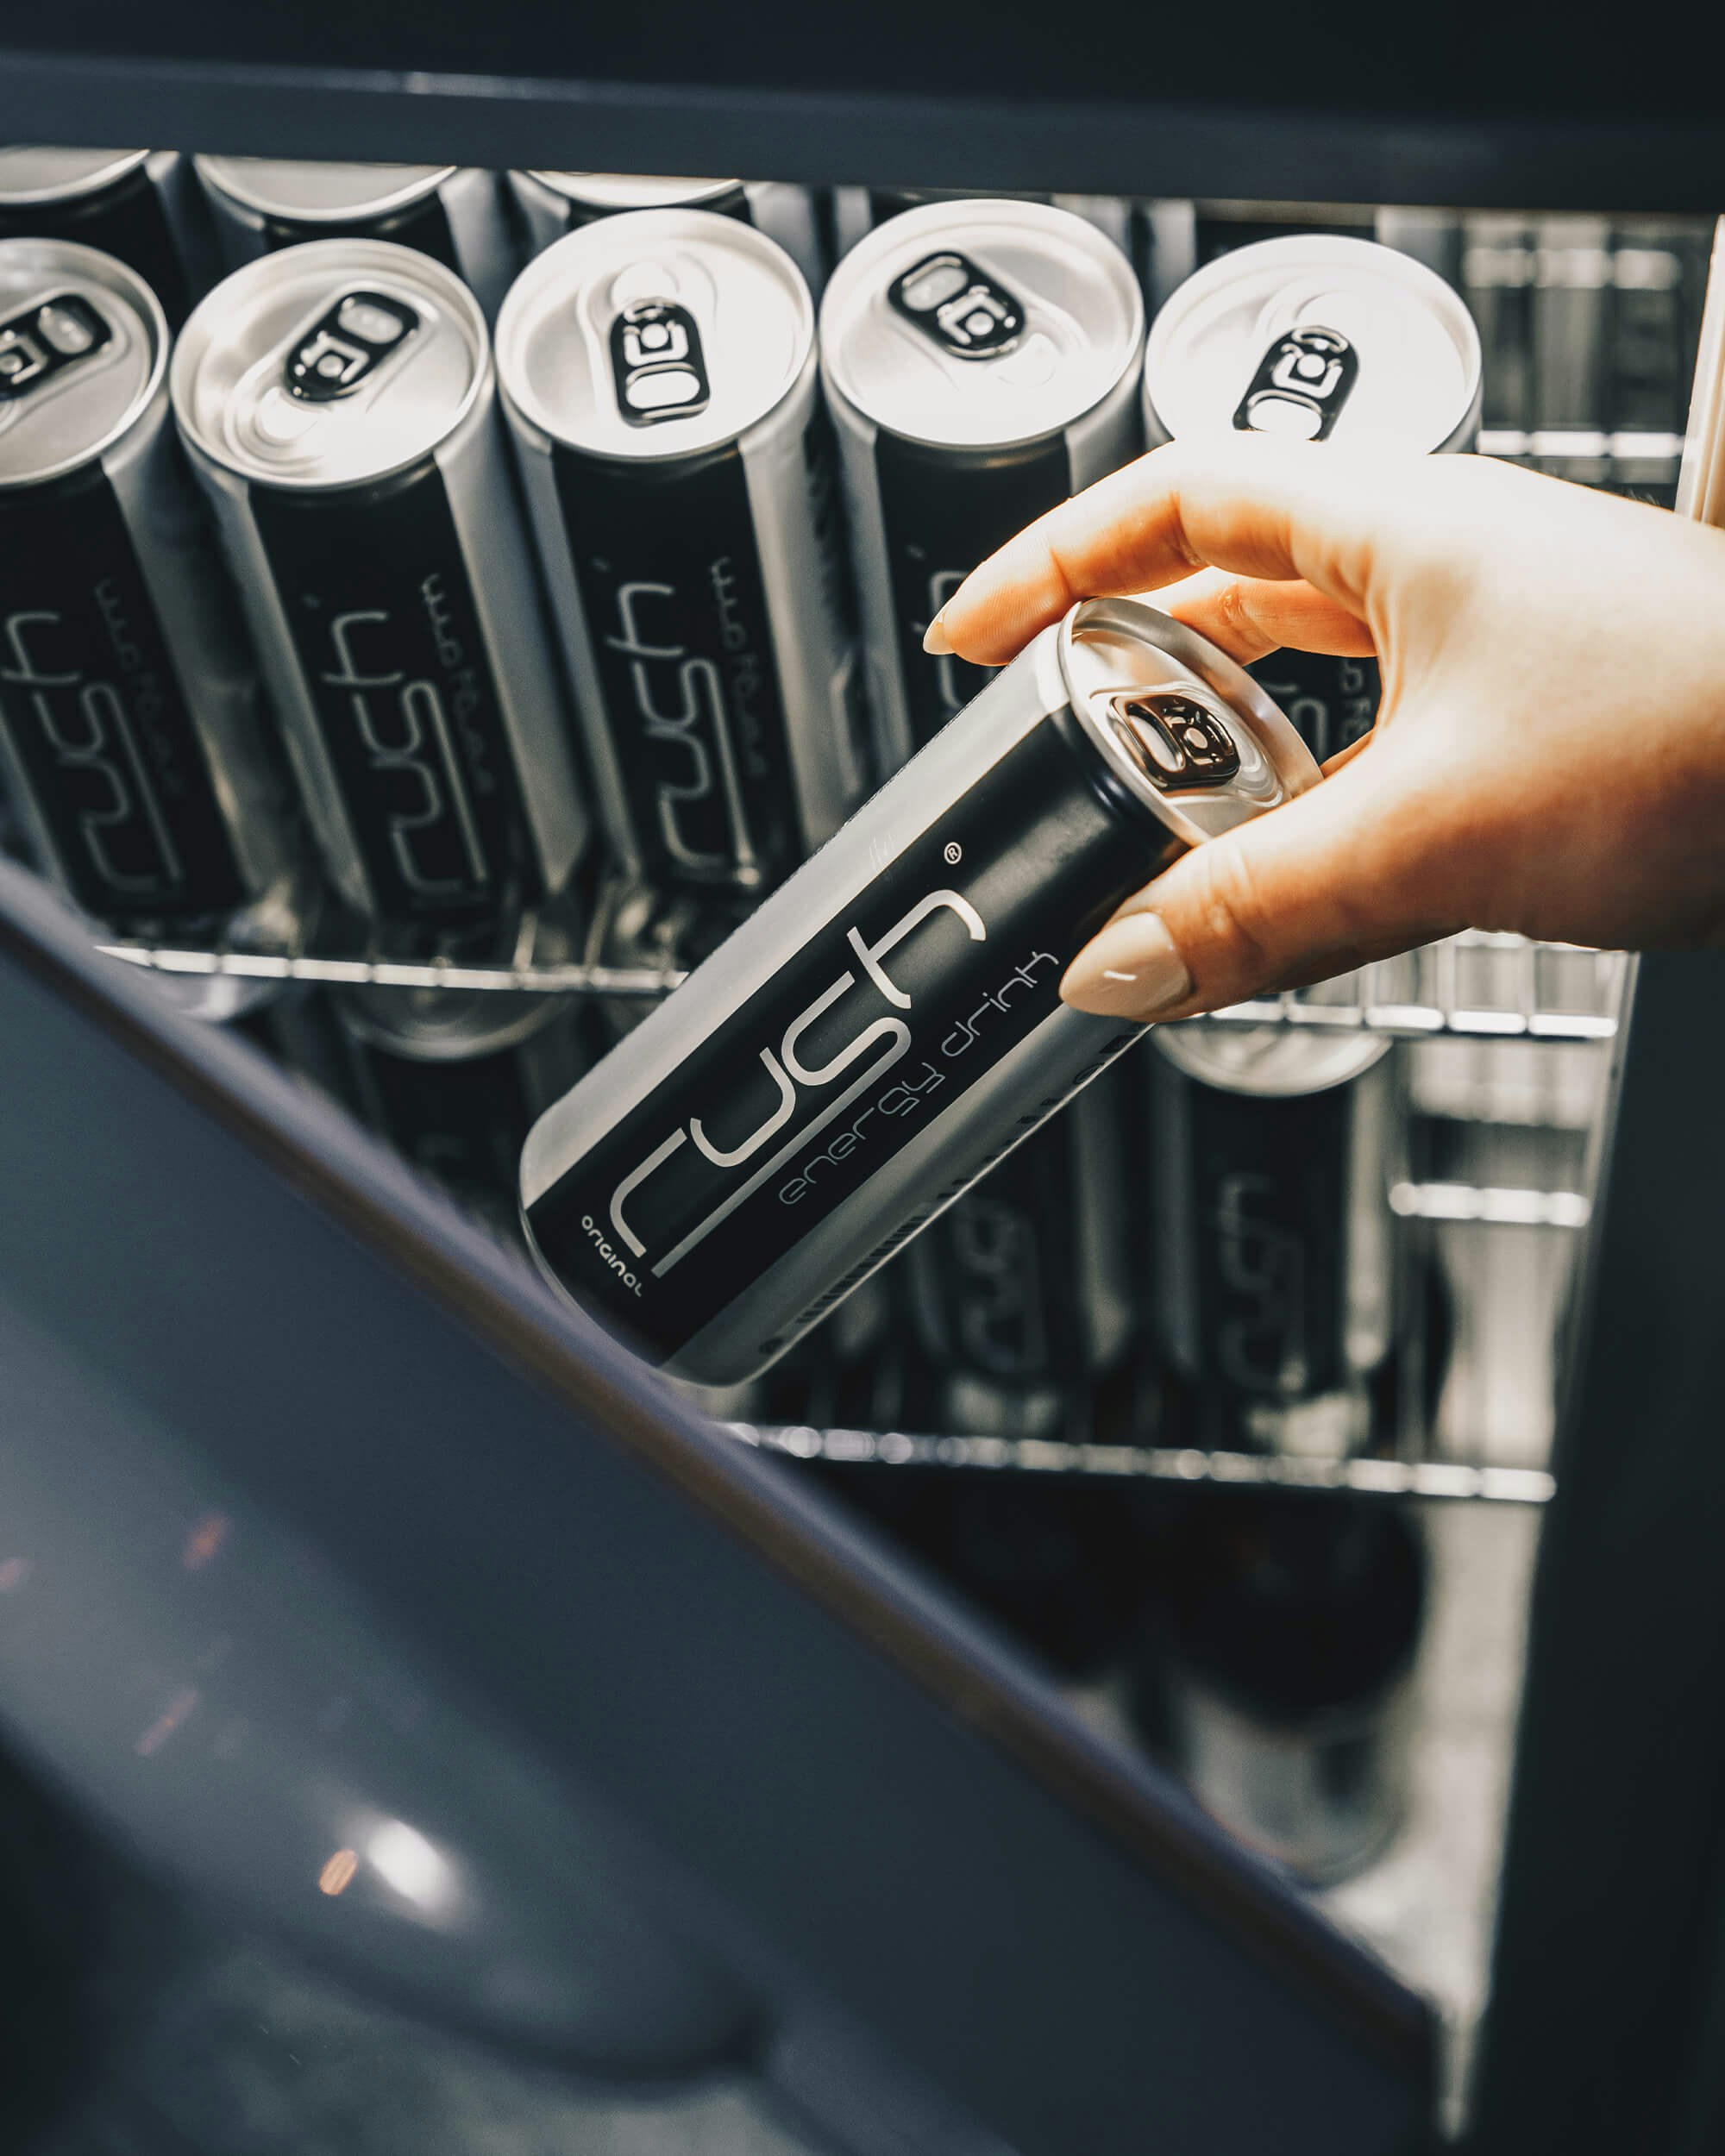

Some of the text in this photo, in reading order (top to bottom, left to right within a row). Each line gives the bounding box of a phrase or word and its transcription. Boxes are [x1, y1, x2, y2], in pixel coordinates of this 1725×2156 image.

[610, 889, 987, 1277] rush
[779, 1062, 946, 1205] energy
[941, 950, 1060, 1057] drink
